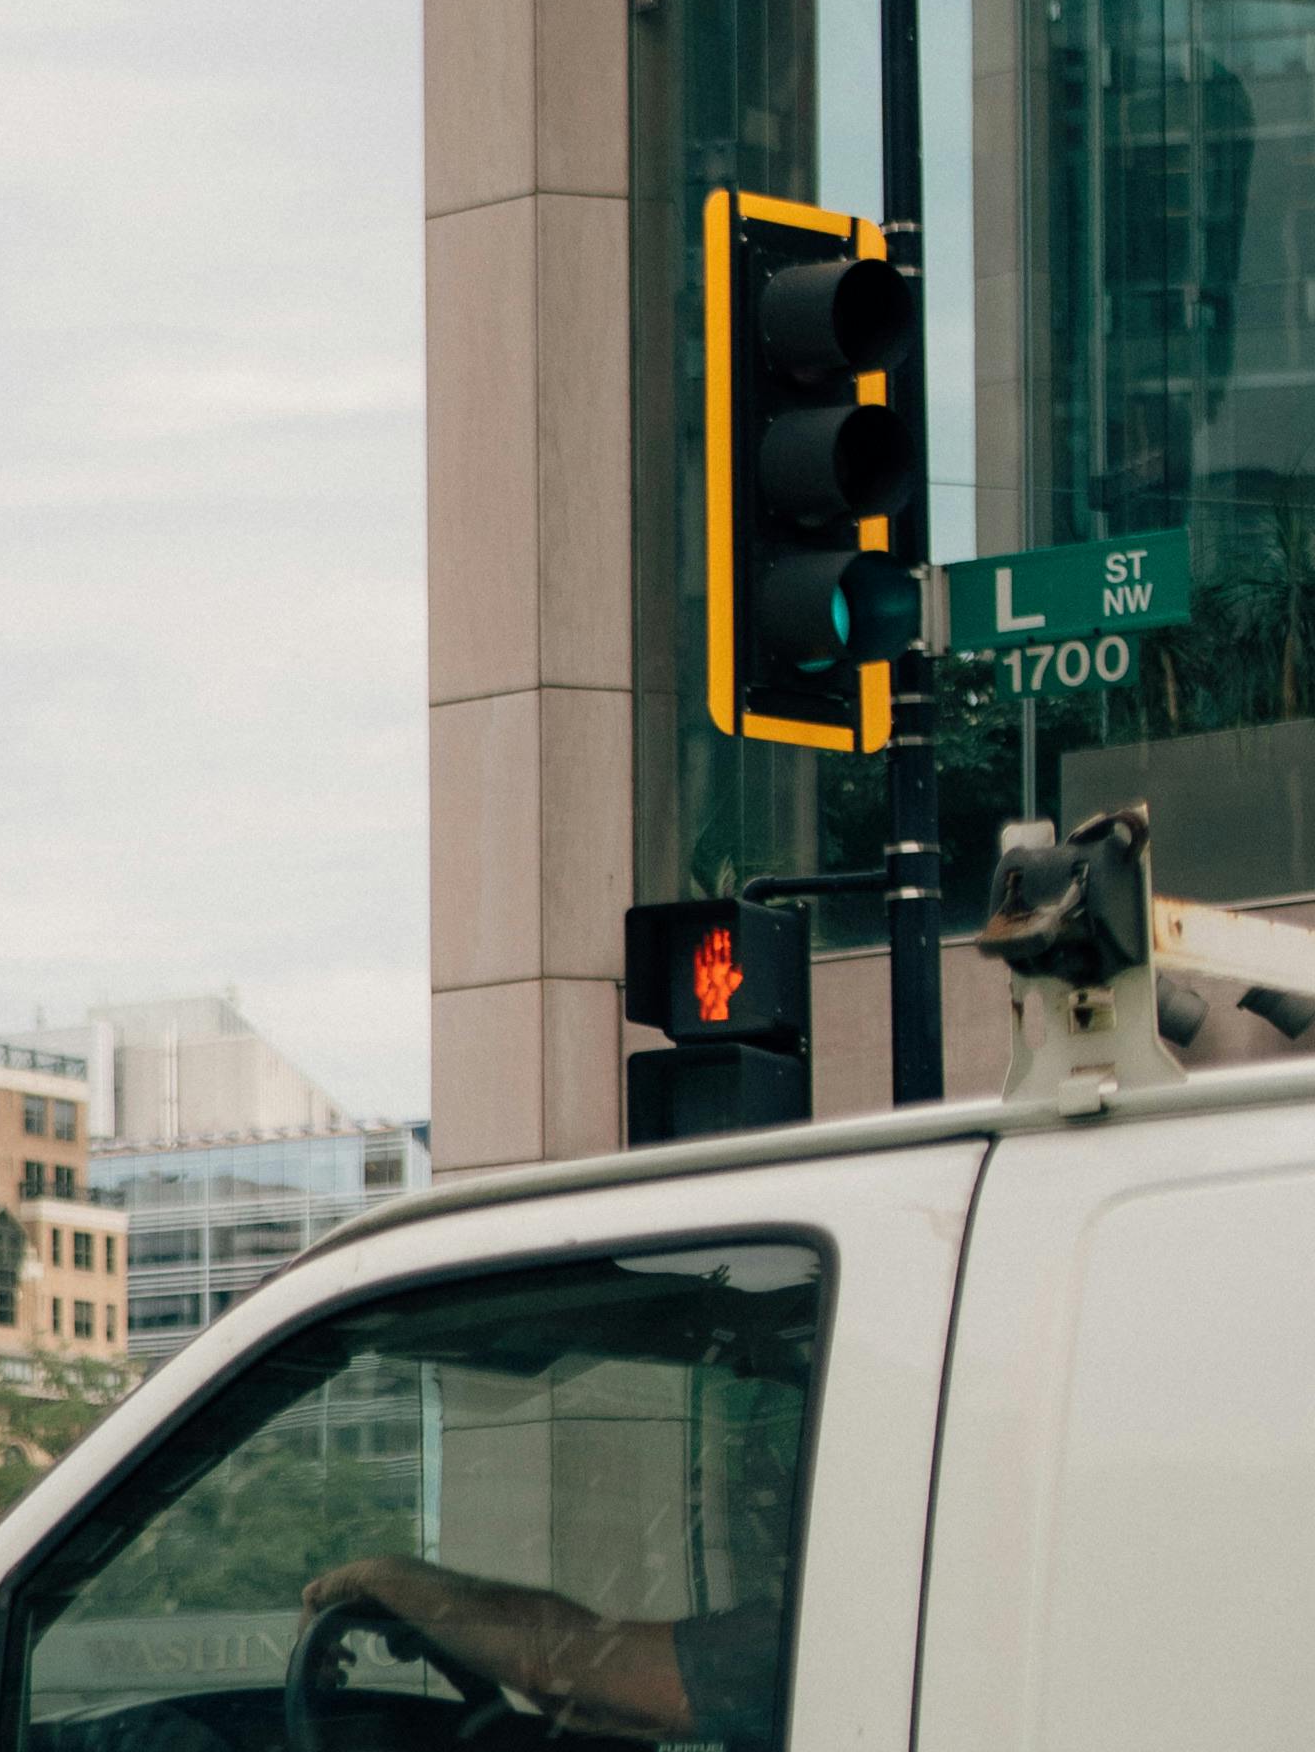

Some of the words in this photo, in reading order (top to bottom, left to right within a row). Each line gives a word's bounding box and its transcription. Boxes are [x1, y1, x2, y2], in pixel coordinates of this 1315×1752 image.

[995, 568, 1046, 633] L
[1105, 550, 1148, 584] ST
[1103, 583, 1153, 617] NW
[1003, 635, 1130, 693] 1700
